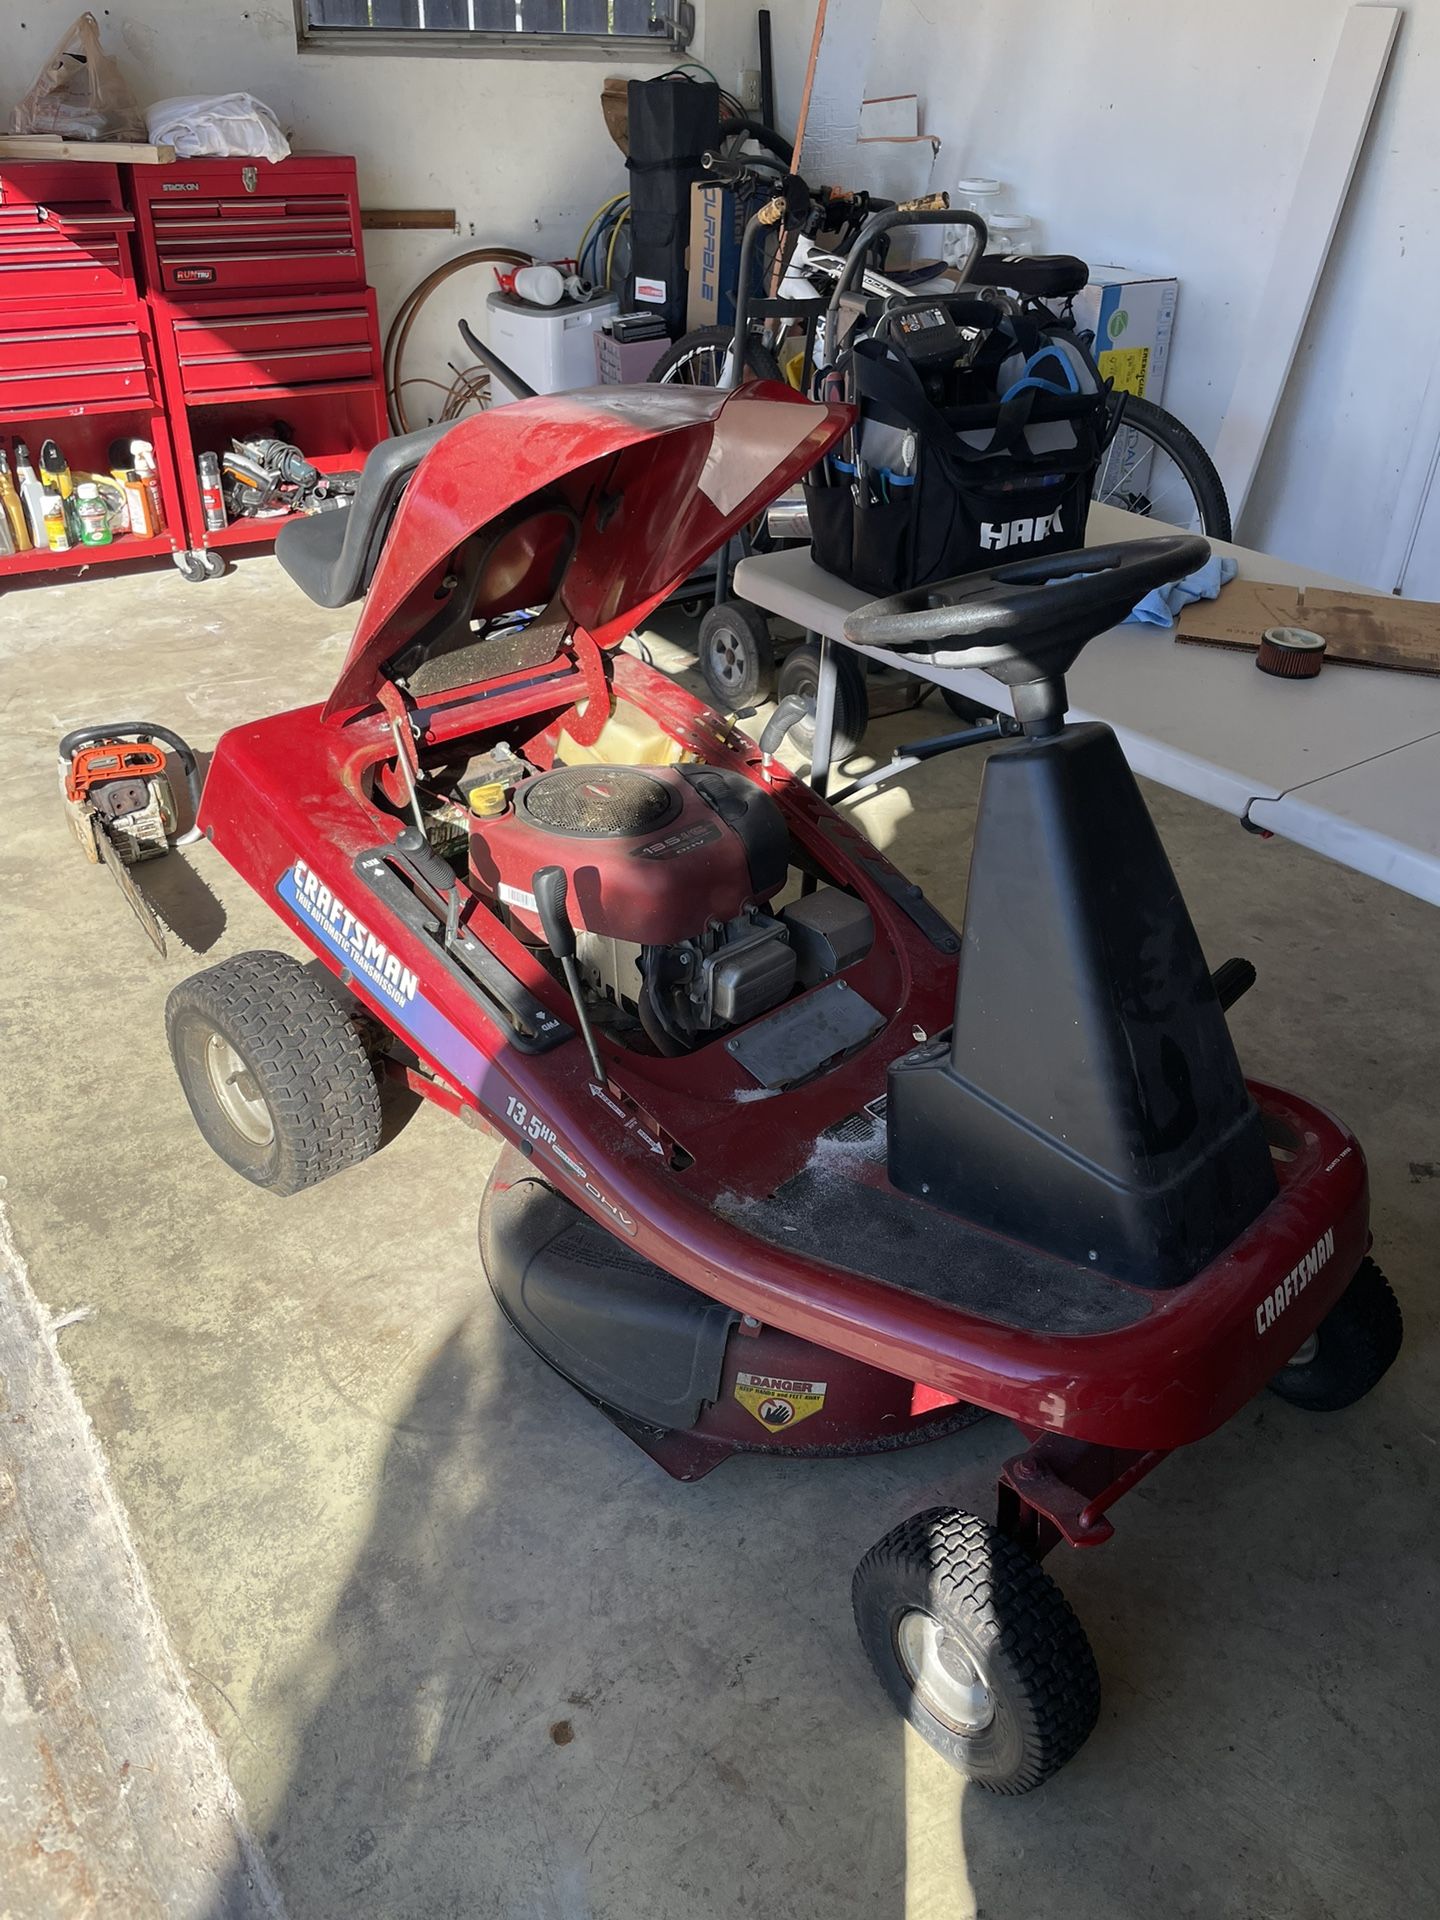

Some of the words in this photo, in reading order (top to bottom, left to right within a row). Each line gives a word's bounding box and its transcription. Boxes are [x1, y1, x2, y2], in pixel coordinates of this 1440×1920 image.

[702, 188, 717, 302] DURABLE
[979, 504, 1064, 550] HART
[293, 860, 418, 1001] CRAFTSMAN
[295, 888, 313, 914] TRUE
[311, 910, 350, 953] AUTOMATIC
[350, 947, 406, 1008] TRANSMISSION
[541, 1019, 560, 1031] FWD
[585, 1182, 632, 1224] OHV
[1256, 1227, 1335, 1335] CRAFTSMAN
[750, 1376, 813, 1392] DANGER
